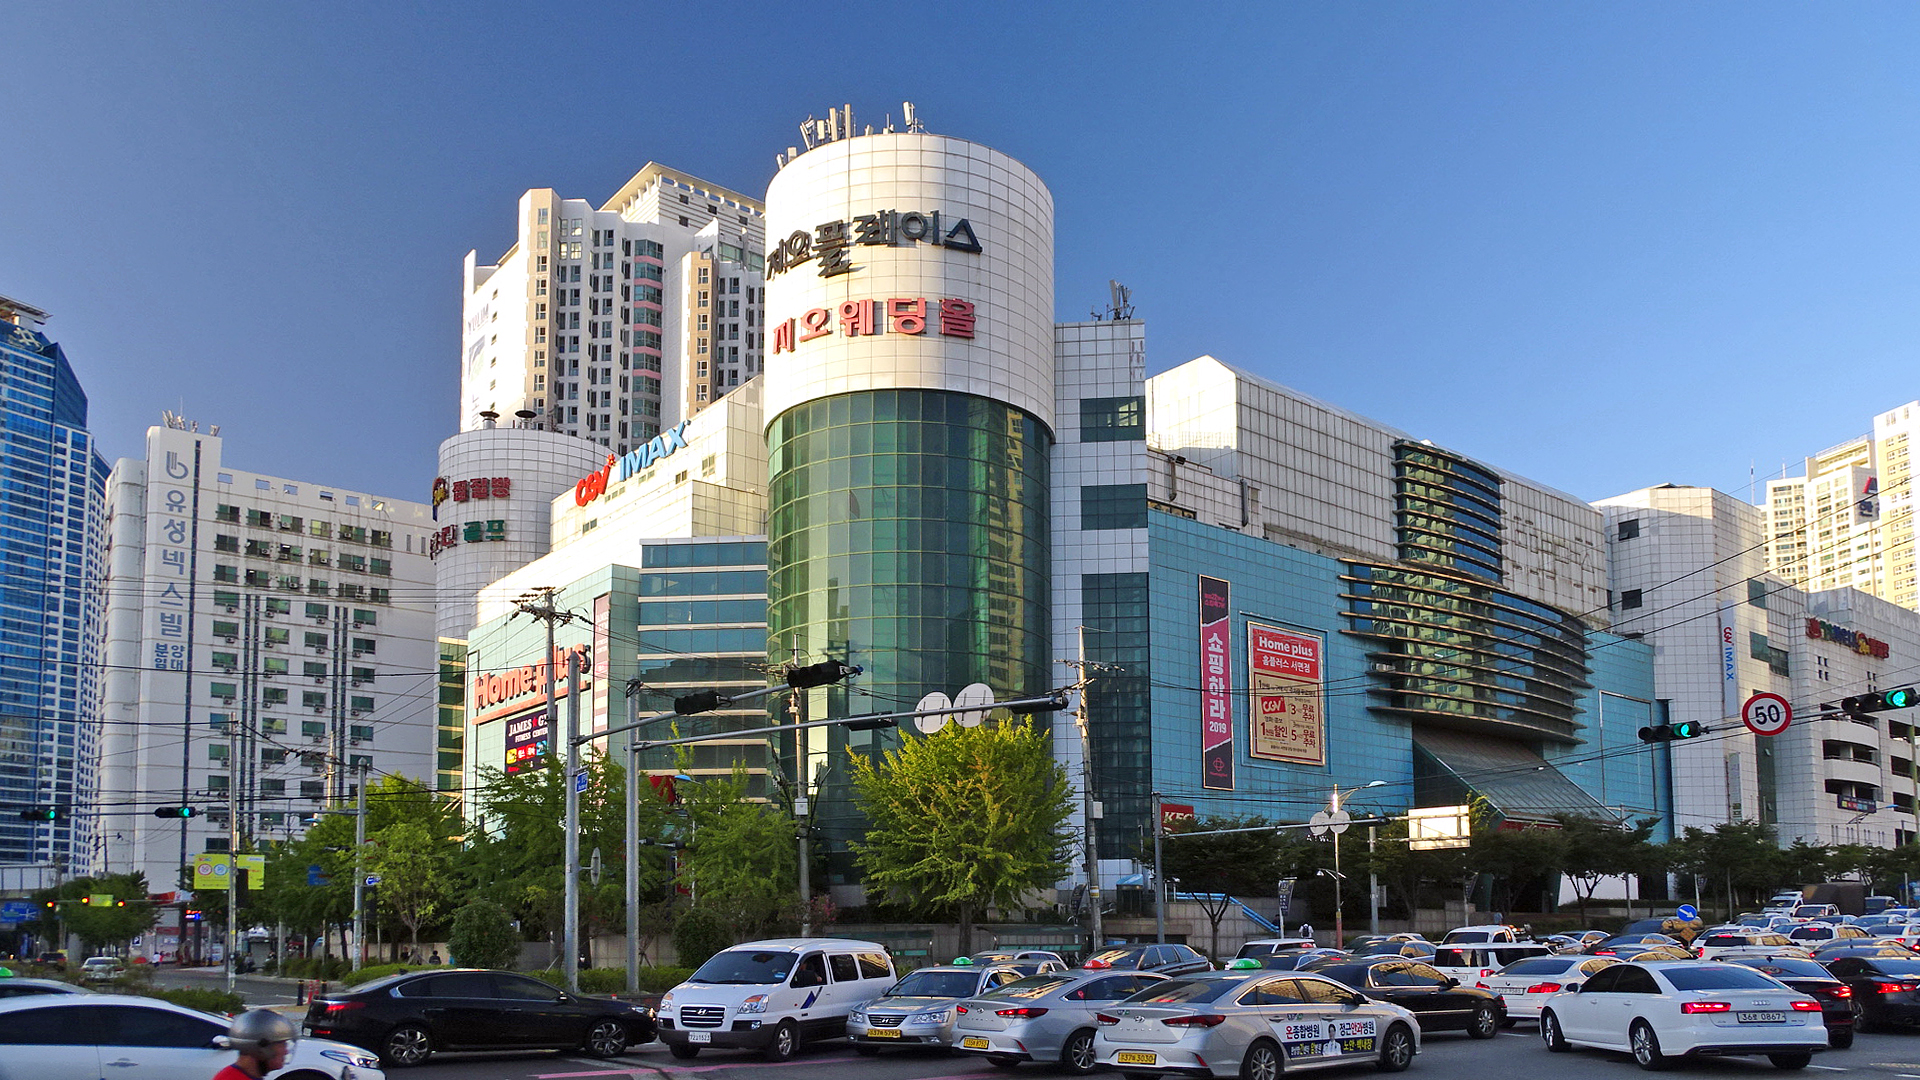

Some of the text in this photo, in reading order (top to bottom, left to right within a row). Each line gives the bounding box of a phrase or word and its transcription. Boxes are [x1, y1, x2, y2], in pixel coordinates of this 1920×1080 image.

[766, 209, 983, 280] 지오플레이스
[773, 298, 976, 354] 지오웨딩홀
[575, 421, 690, 507] CGV IMAX
[463, 520, 505, 542] 골프
[1259, 636, 1313, 657] Home plus
[1262, 655, 1289, 669] 홈플러스
[1725, 647, 1734, 680] IMAX
[474, 664, 533, 709] Home
[1208, 633, 1226, 721] 쇼핑하라
[1262, 699, 1281, 713] CGV
[1754, 704, 1780, 725] 50
[508, 719, 532, 737] JAMES
[1209, 721, 1227, 734] 2019
[1286, 1024, 1319, 1039] 온종합병원
